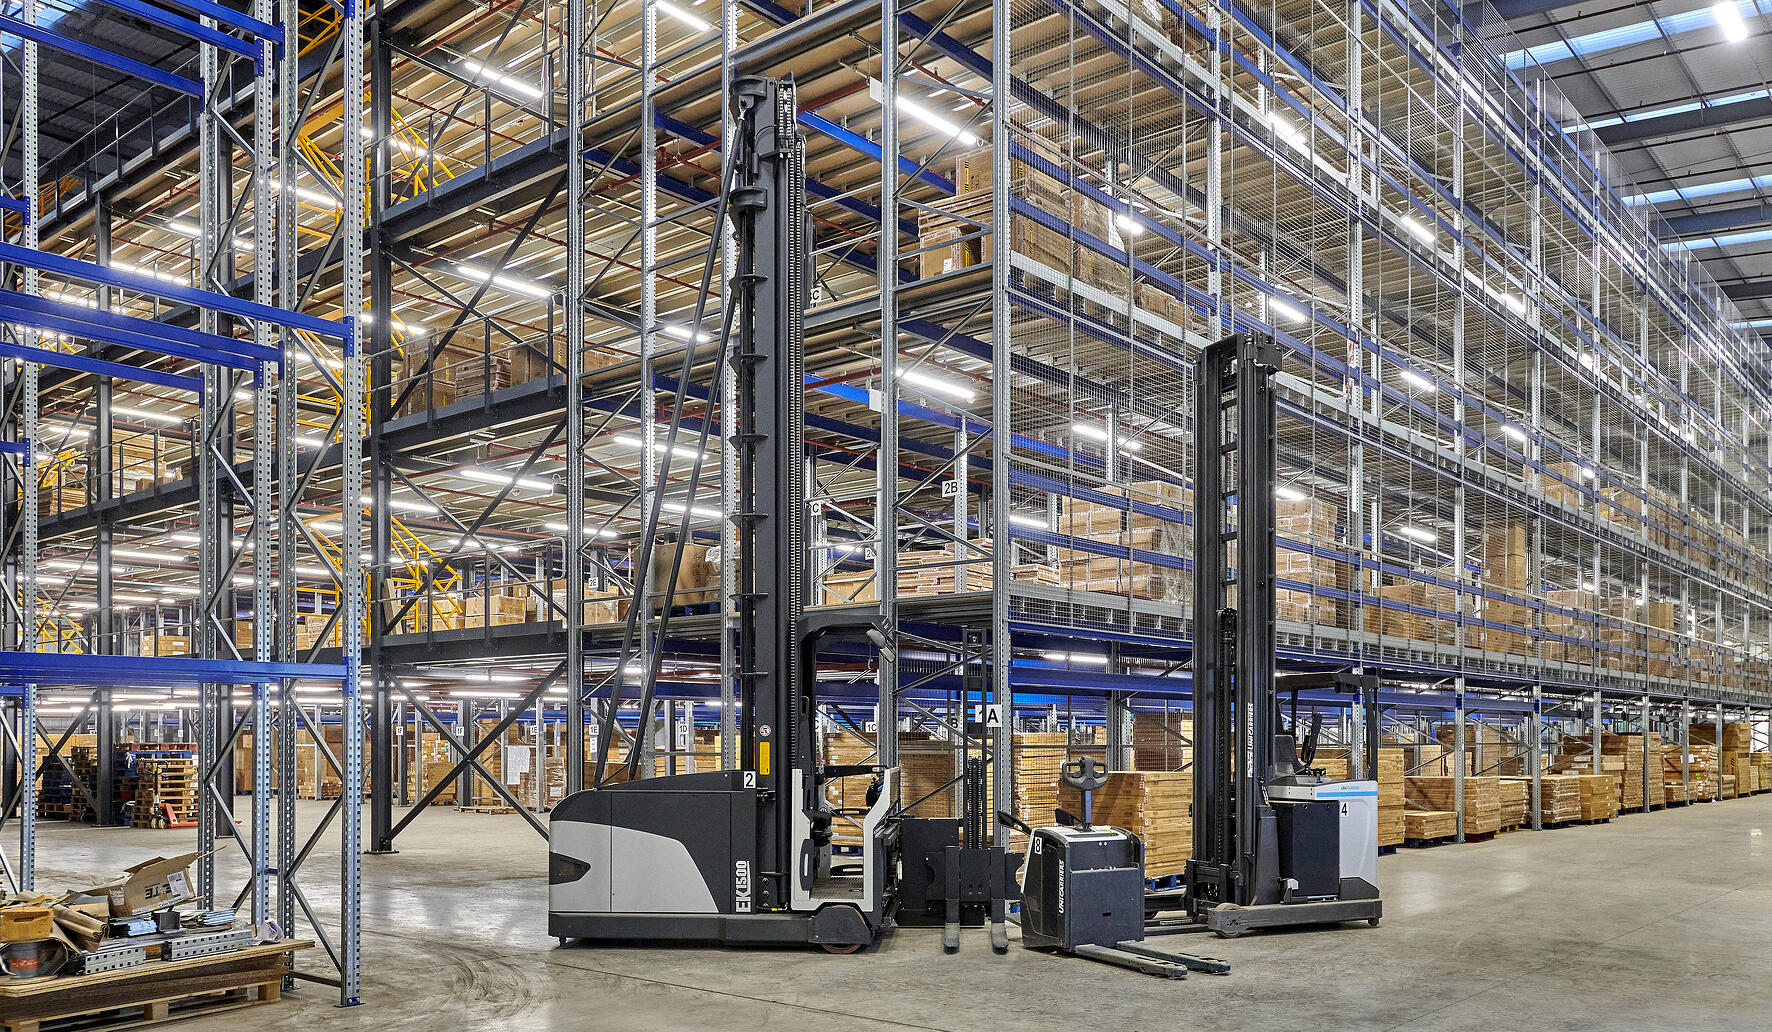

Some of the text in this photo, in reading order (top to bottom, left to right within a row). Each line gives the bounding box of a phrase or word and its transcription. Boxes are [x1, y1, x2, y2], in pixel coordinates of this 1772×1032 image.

[945, 481, 958, 495] 2B
[745, 772, 754, 787] 2
[1341, 802, 1348, 816] 4
[1035, 838, 1041, 853] 8
[735, 860, 751, 913] EK1500
